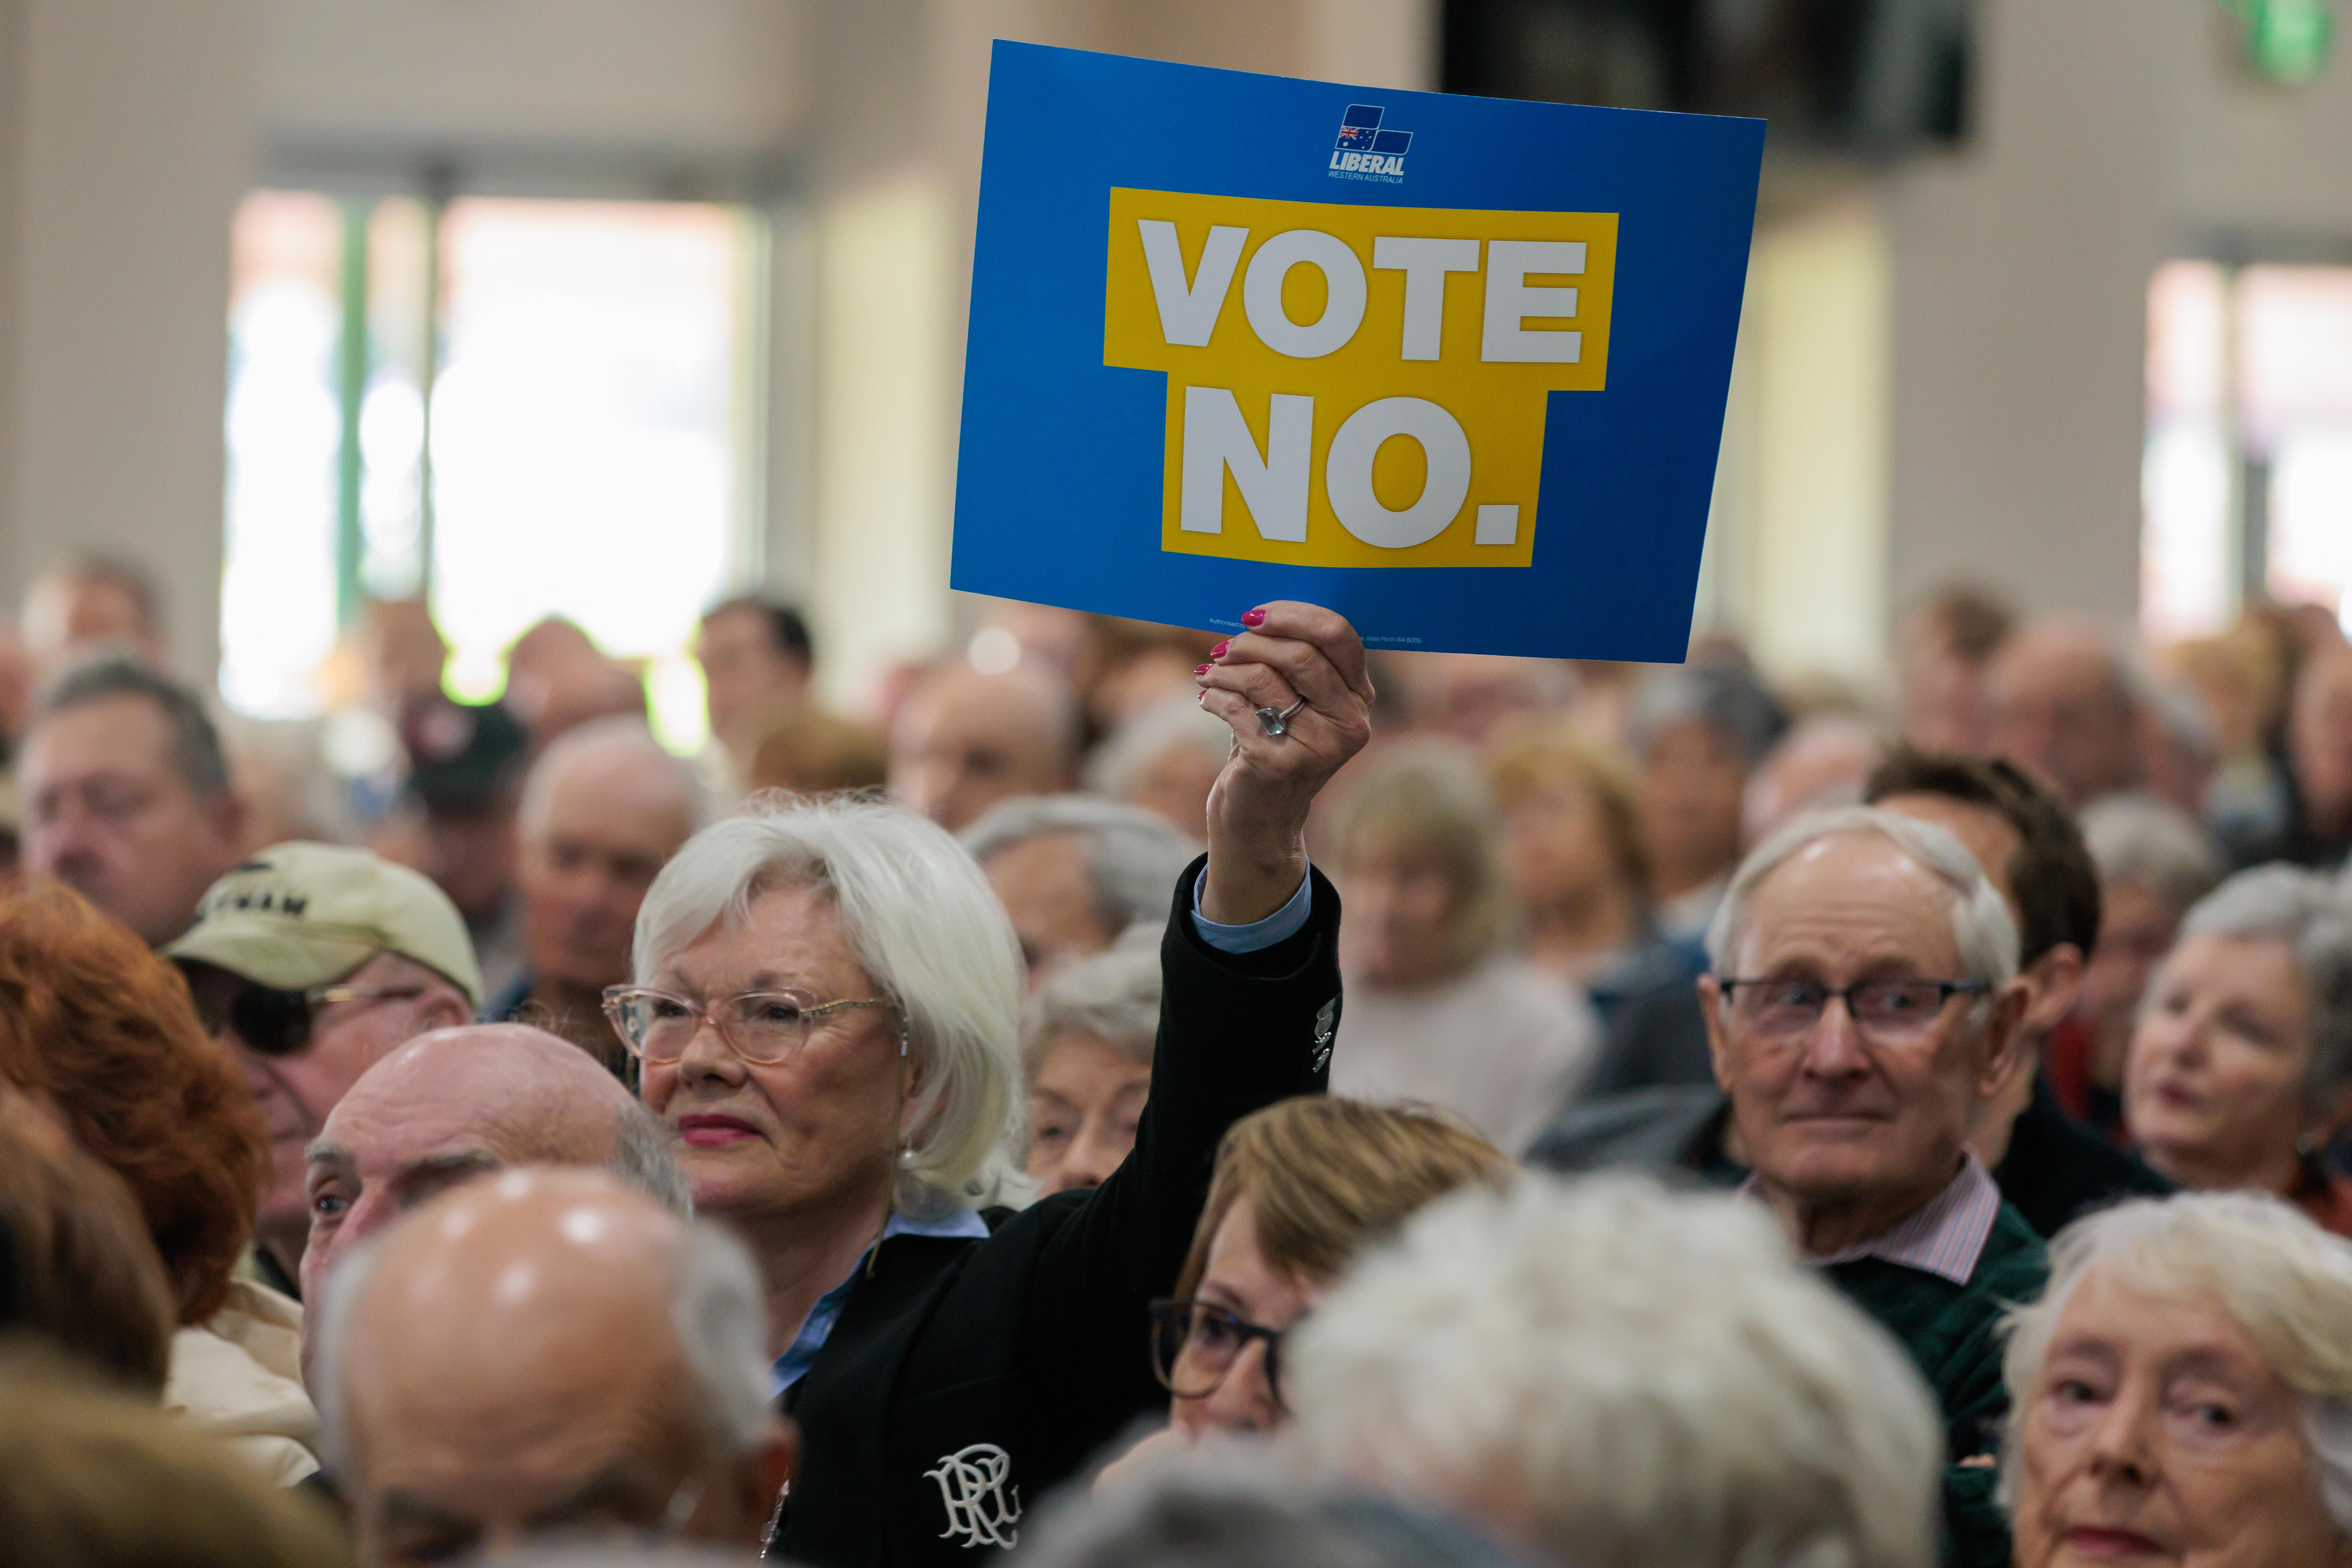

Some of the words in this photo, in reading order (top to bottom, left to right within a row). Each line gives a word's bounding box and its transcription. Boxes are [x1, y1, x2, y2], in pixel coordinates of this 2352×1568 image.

[1329, 151, 1404, 176] LIBERAL
[1328, 171, 1363, 180] WESTERN
[1364, 174, 1403, 184] AUSTRALIA
[1137, 219, 1587, 364] VOTE
[1181, 386, 1518, 549] NO.
[1209, 618, 1239, 627] Authorised
